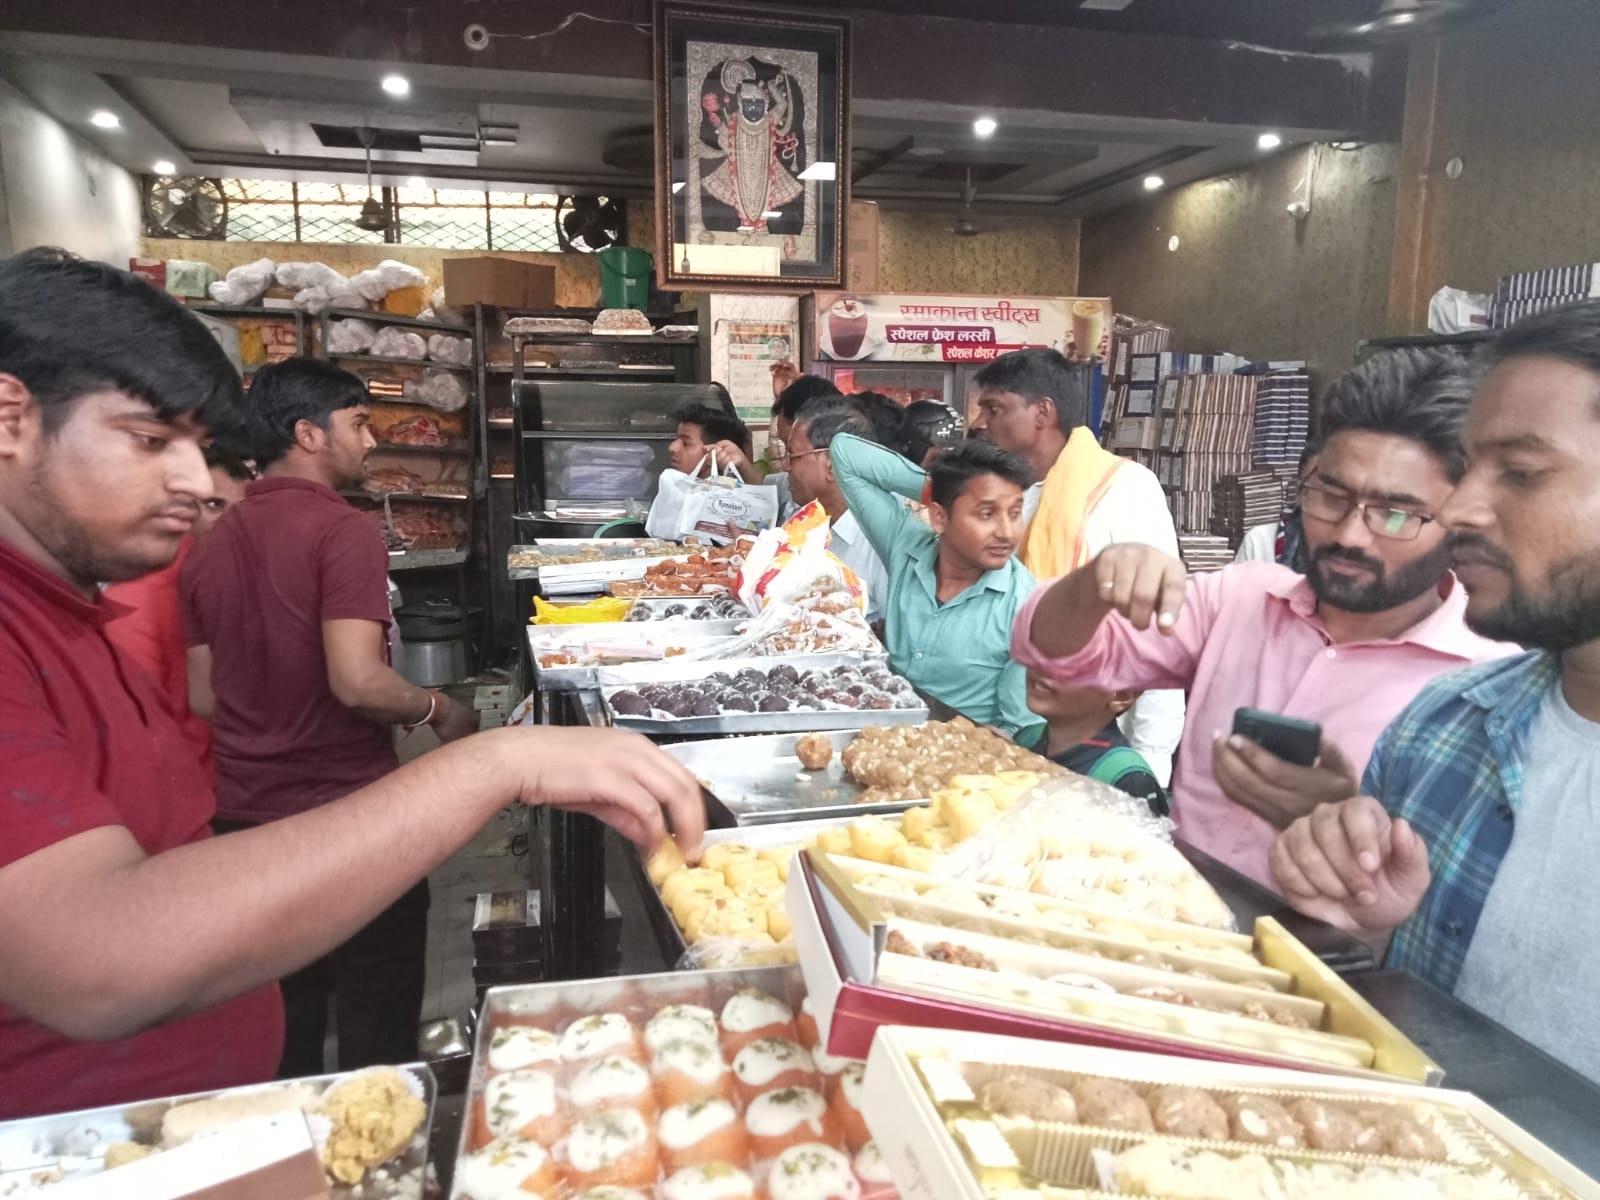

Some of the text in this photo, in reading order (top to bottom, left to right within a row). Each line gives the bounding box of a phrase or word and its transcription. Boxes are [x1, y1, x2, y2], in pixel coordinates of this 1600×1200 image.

[981, 301, 1041, 326] स्वीट्स
[890, 327, 991, 342] स्पेशल फ्रेश लस्सी
[946, 346, 973, 359] स्पेशल
